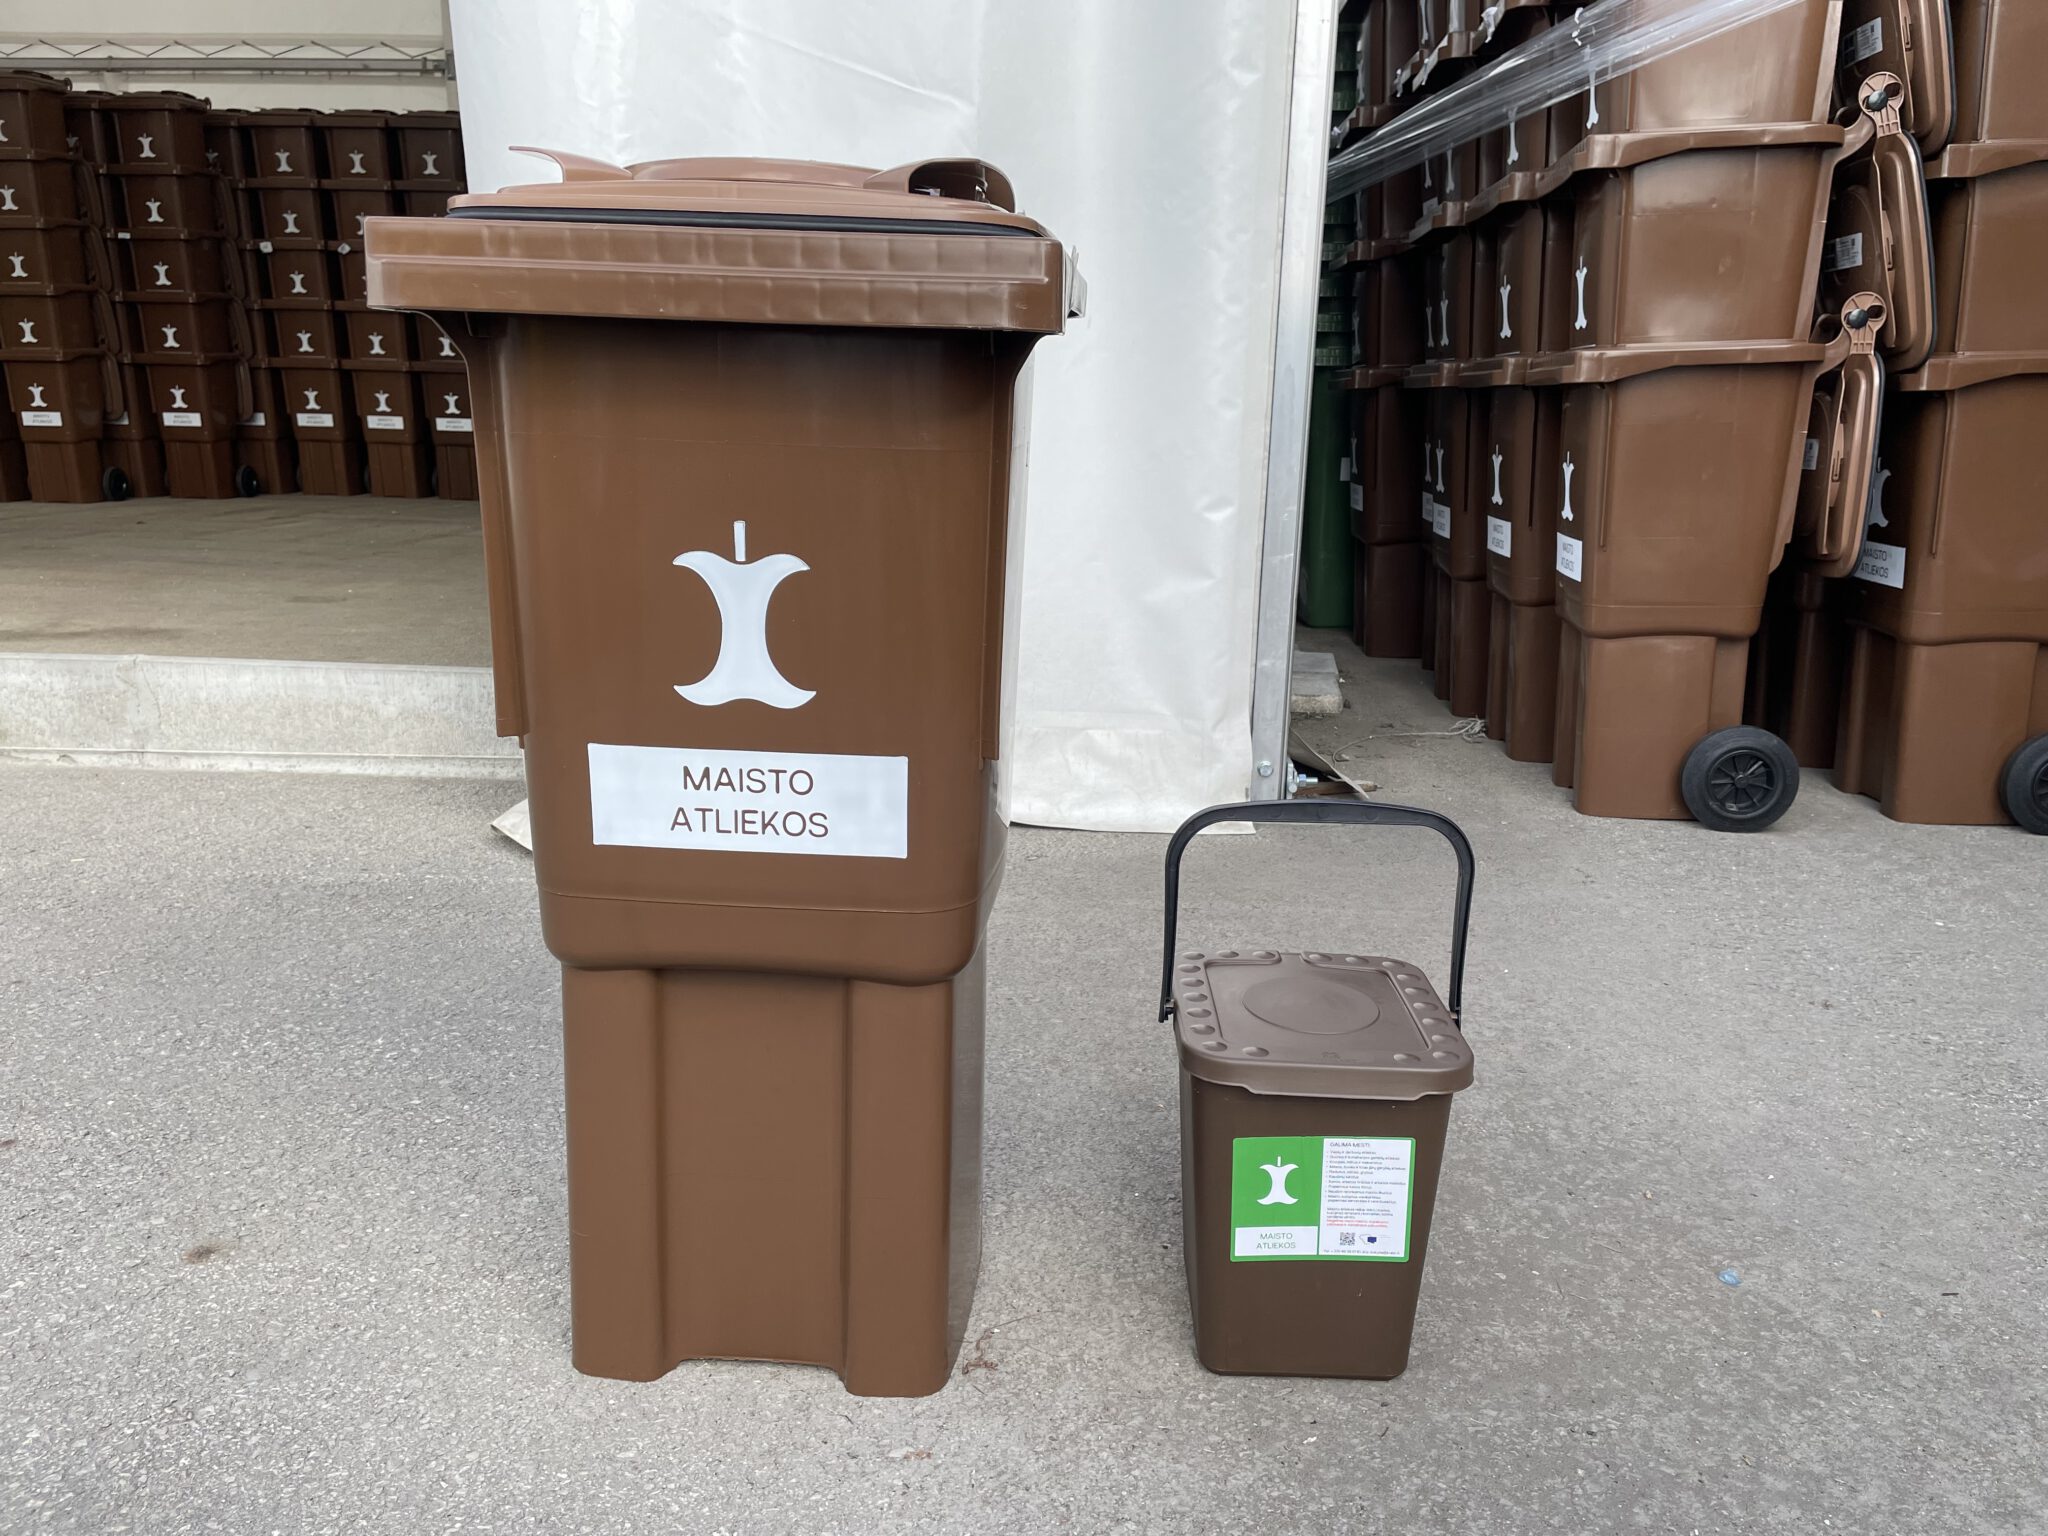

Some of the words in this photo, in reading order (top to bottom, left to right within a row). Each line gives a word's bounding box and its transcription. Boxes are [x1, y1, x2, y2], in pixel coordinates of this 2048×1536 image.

[683, 765, 814, 796] MAISTO
[670, 806, 829, 838] ATLIEKOS
[1260, 1232, 1293, 1240] MAISTO
